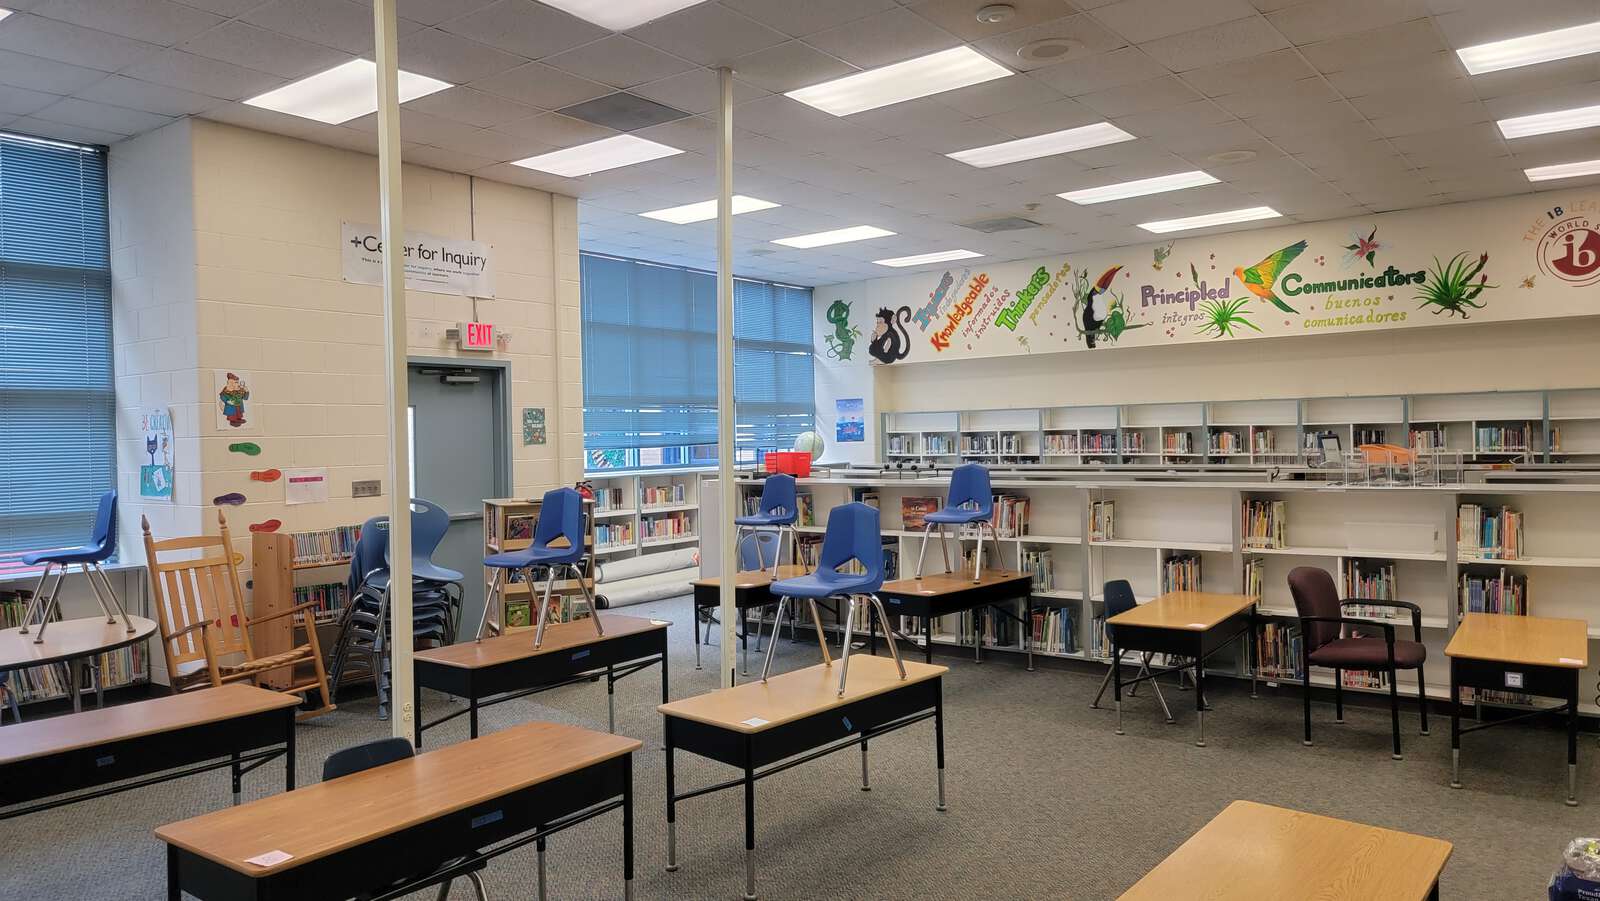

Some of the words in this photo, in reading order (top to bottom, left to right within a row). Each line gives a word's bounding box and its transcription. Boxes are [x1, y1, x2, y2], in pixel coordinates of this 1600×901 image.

[1547, 206, 1563, 220] IB
[1548, 220, 1589, 239] WORLD
[418, 243, 438, 260] for
[442, 247, 487, 271] Inquiry
[1029, 262, 1071, 327] pensadores
[1141, 277, 1231, 312] Principled
[1281, 265, 1427, 296] Communicators
[929, 272, 990, 352] Knowledgeable
[961, 285, 999, 338] informados
[975, 289, 1011, 339] instruidos
[994, 265, 1051, 332] Thinkers
[1324, 294, 1382, 311] buenos
[467, 323, 493, 346] EXIT
[1303, 309, 1408, 329] comunicadores
